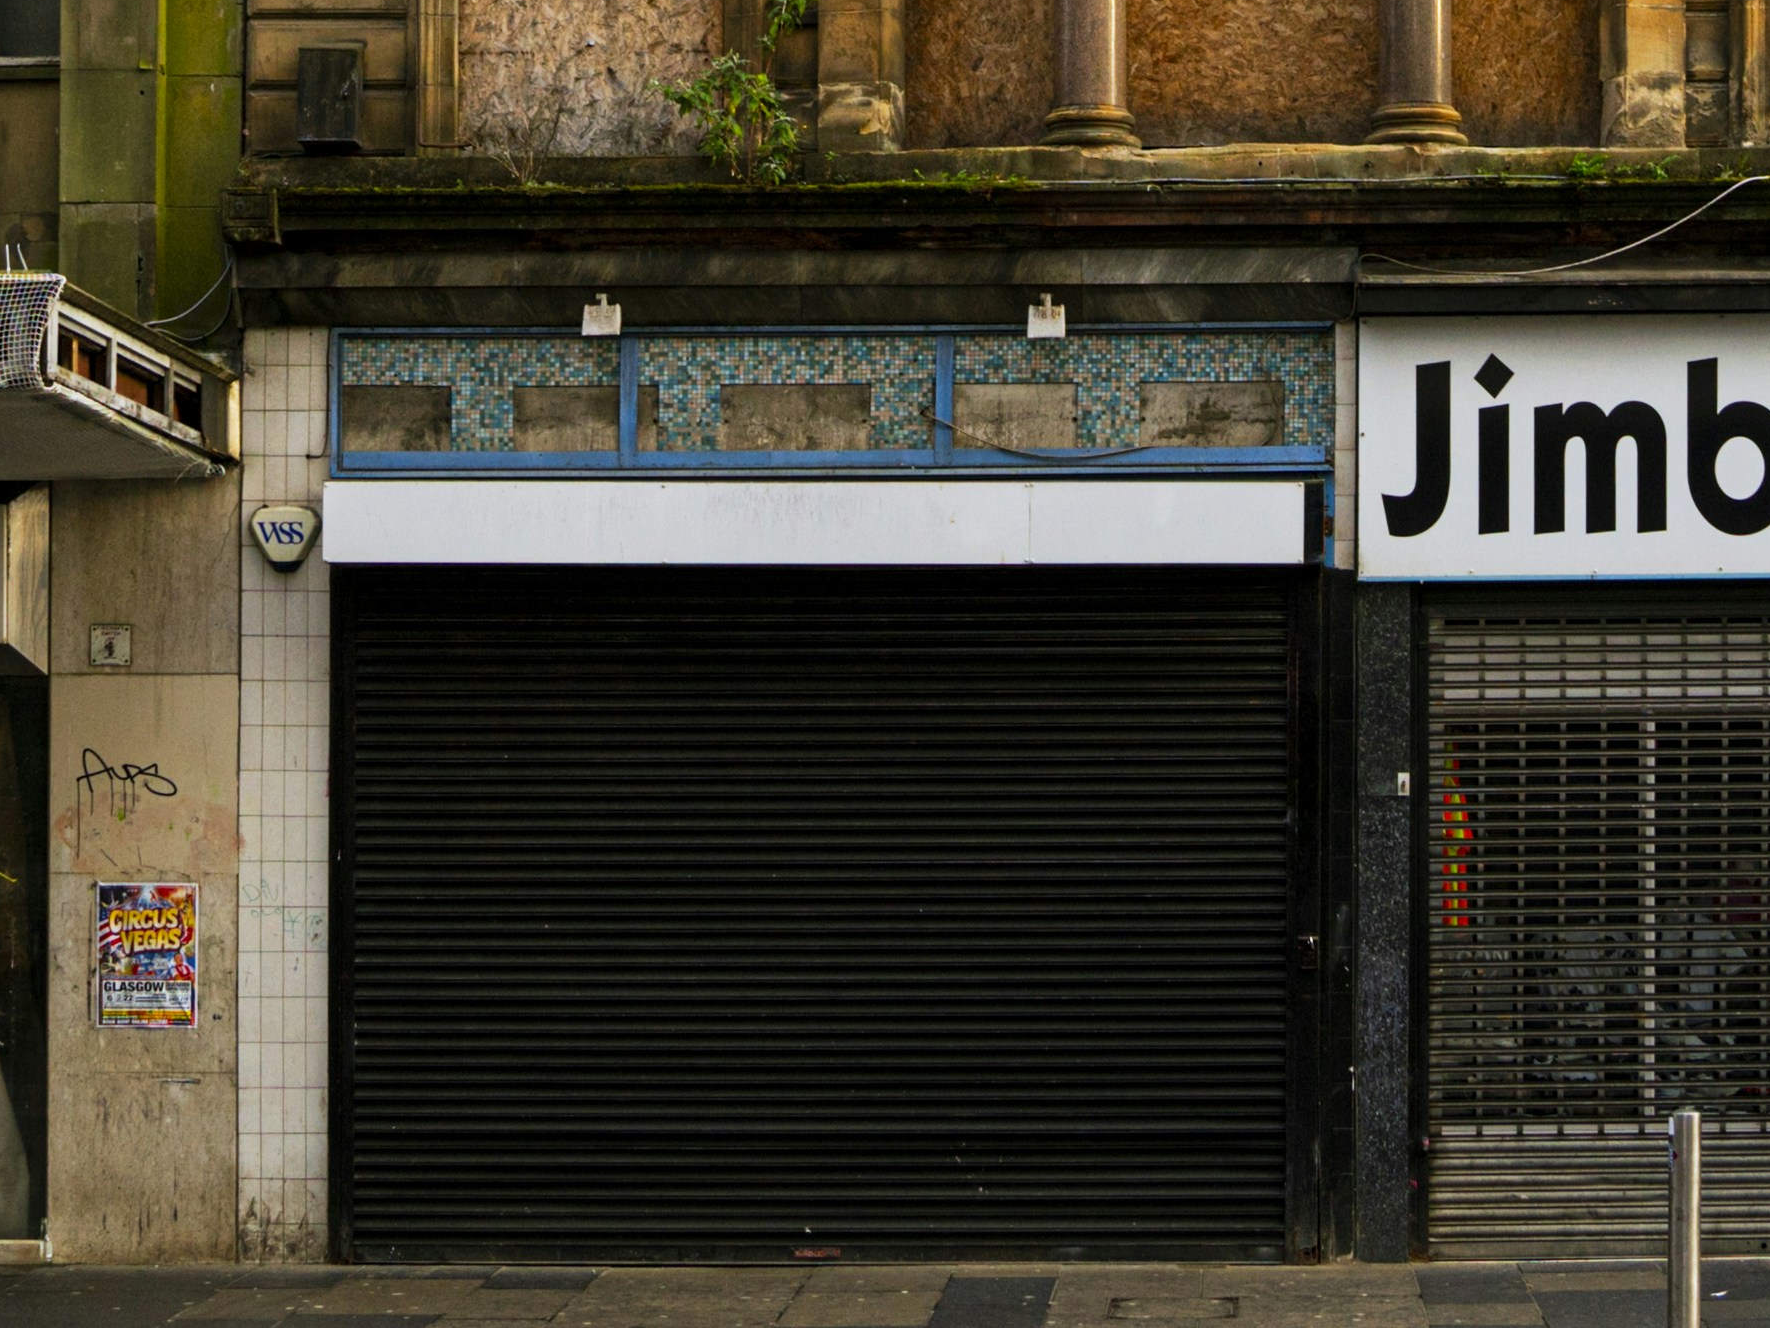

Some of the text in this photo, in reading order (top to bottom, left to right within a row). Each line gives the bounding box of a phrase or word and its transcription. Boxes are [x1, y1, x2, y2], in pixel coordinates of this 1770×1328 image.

[109, 907, 181, 935] CIRCUS
[119, 928, 182, 957] VEGAS
[103, 981, 165, 992] GLASGOW
